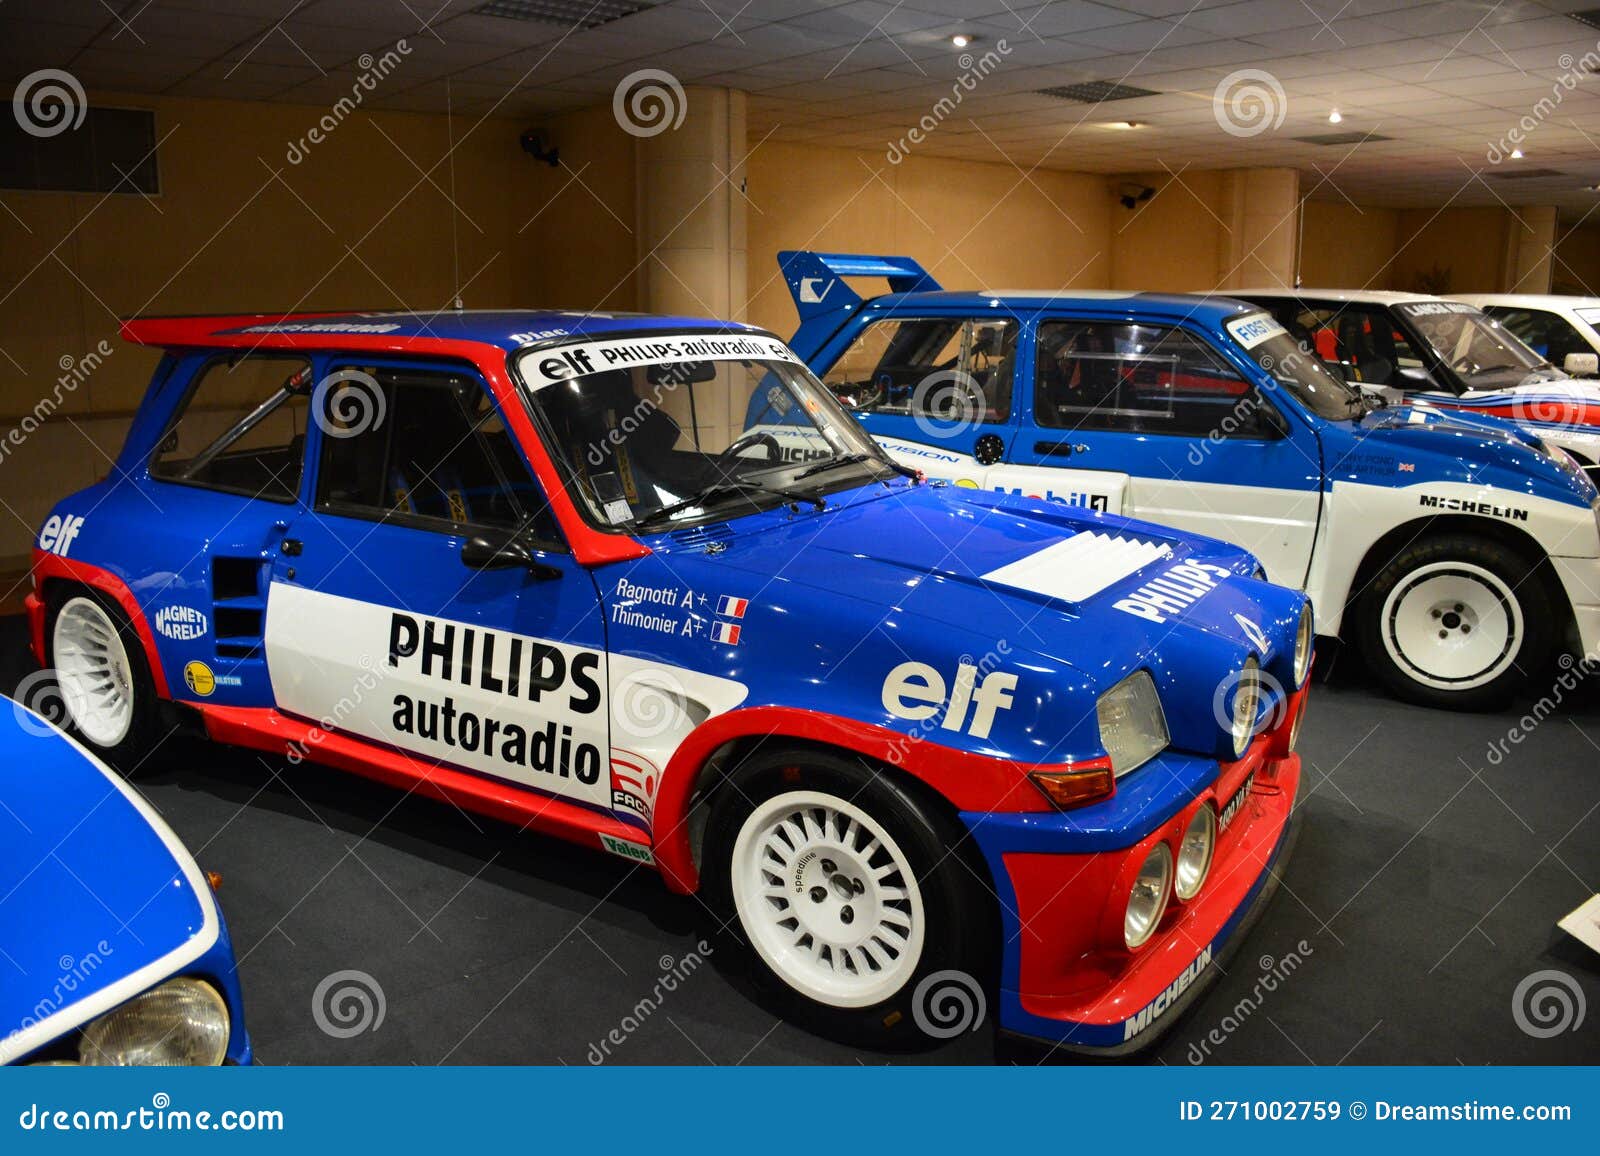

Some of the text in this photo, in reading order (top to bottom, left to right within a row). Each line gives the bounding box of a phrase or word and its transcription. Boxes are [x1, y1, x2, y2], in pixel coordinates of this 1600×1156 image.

[539, 349, 596, 380] elf
[600, 343, 682, 364] PHILIPS
[681, 338, 766, 357] autoradio
[876, 441, 960, 463] VISION
[1419, 494, 1529, 521] MICHELIN
[40, 514, 85, 557] elf
[616, 578, 679, 605] Ragnotti
[1112, 558, 1231, 624] PHILIPS
[156, 605, 207, 627] MAGNETI
[612, 604, 678, 634] Thimonier
[389, 612, 601, 714] PHILIPS
[882, 661, 1019, 739] elf
[392, 694, 601, 785] autoradio
[794, 851, 817, 893] speedline
[1124, 943, 1212, 1041] MICHELIN
